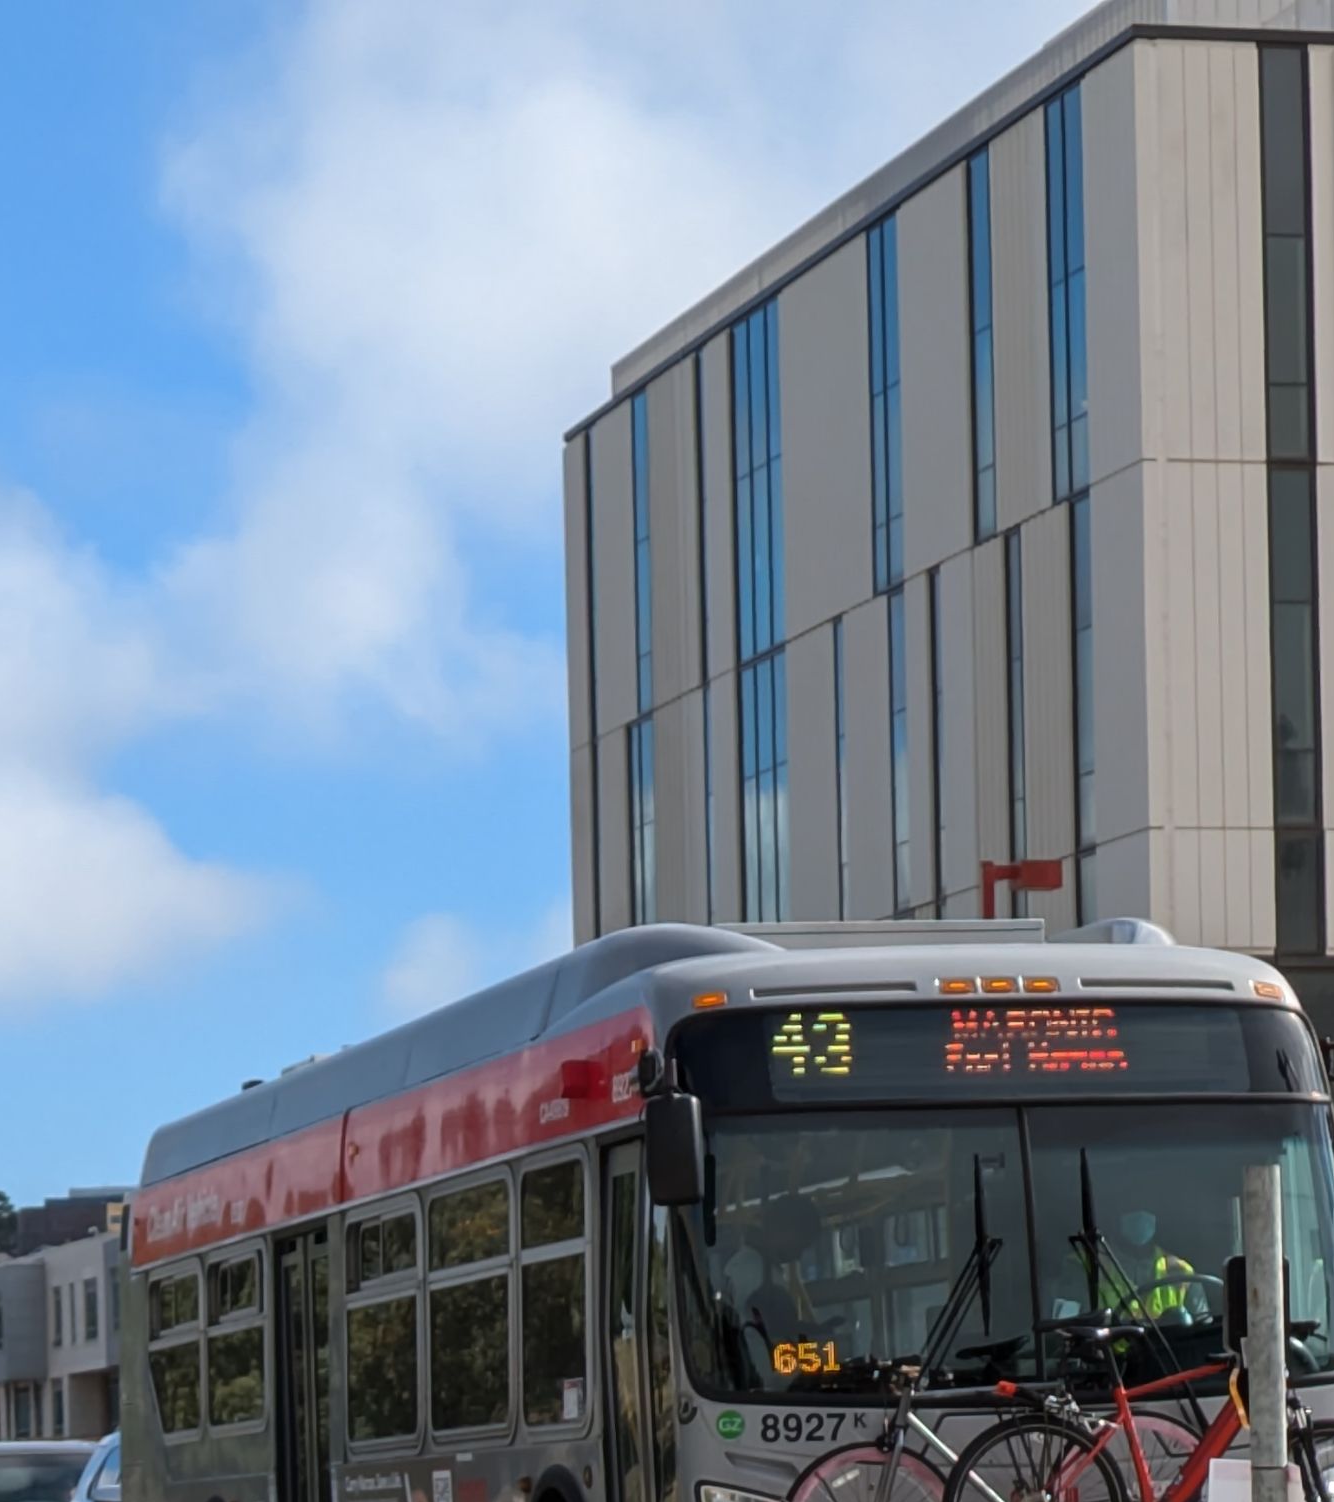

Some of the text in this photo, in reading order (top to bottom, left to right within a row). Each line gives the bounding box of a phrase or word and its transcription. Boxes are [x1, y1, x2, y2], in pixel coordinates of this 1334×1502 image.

[772, 1012, 853, 1075] 43
[772, 1341, 841, 1374] 651
[761, 1413, 867, 1442] 8927 K
